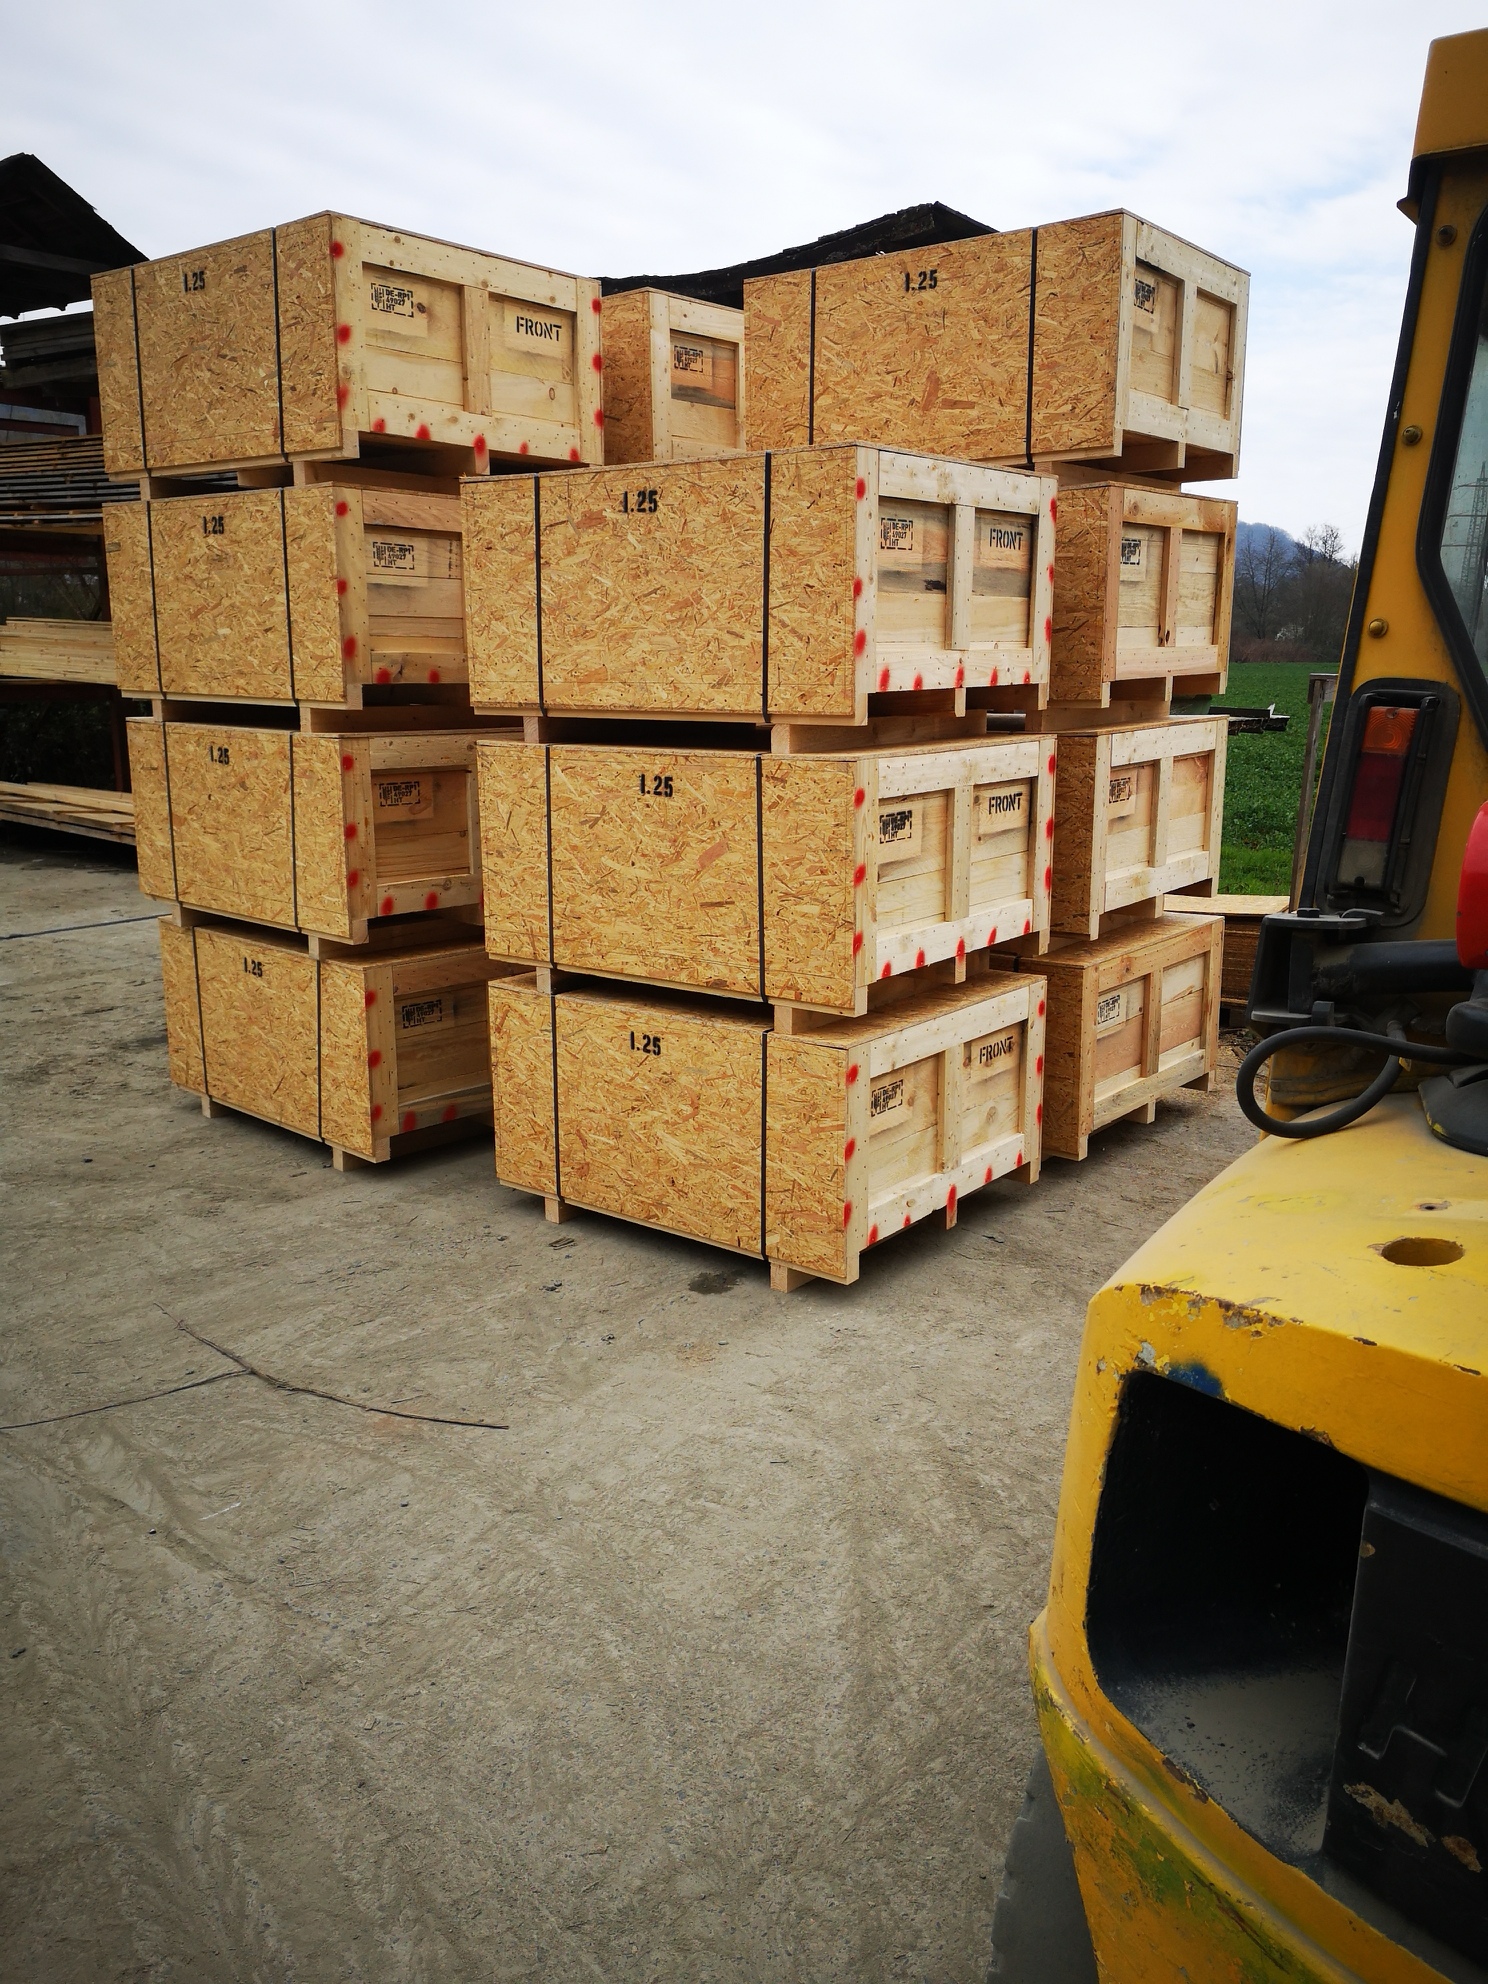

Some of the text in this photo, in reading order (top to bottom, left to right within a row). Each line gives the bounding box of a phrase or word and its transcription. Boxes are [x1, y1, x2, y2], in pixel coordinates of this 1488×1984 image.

[904, 268, 938, 293] 1.25
[516, 315, 562, 342] FRONT
[623, 490, 658, 513] 1.25
[202, 516, 225, 535] 1.25
[989, 527, 1024, 551] FRONT
[210, 745, 230, 765] 1.25
[640, 773, 674, 798] 1.25
[988, 792, 1023, 815] FRONT
[243, 956, 263, 978] 1.25
[630, 1030, 662, 1056] 1.25
[979, 1035, 1014, 1064] FRONT
